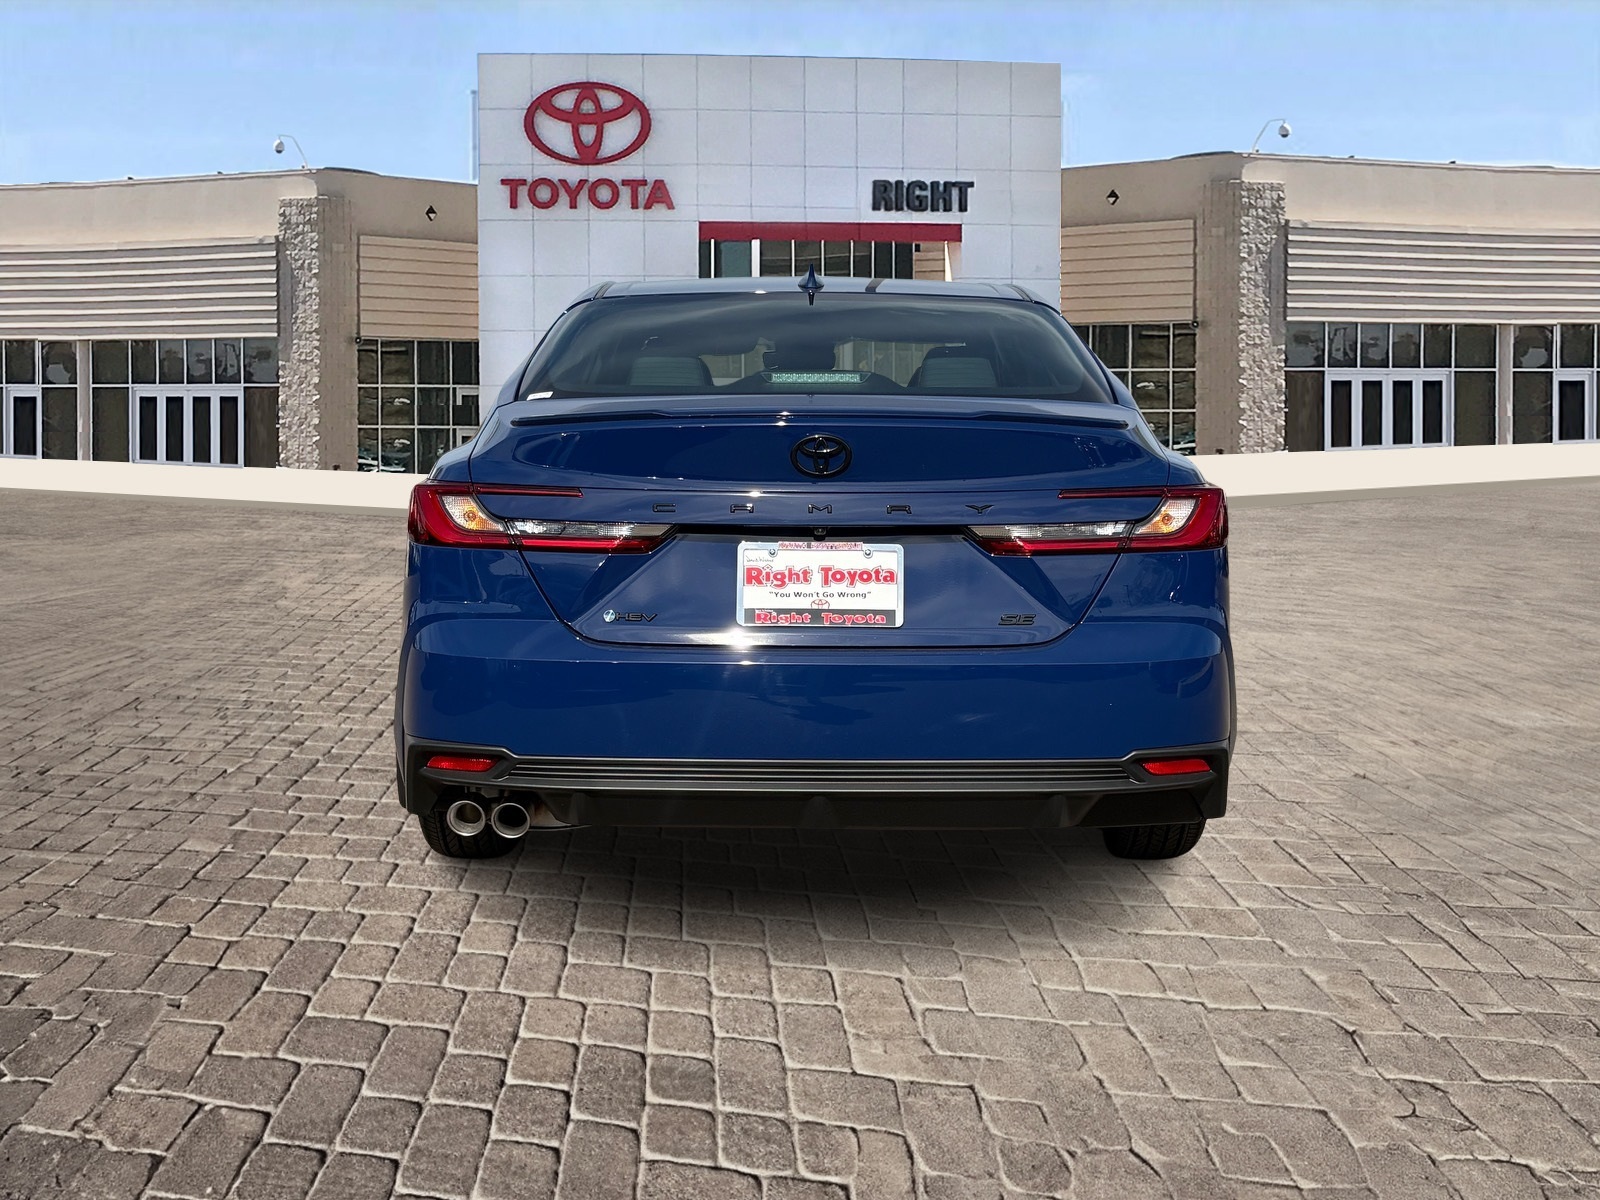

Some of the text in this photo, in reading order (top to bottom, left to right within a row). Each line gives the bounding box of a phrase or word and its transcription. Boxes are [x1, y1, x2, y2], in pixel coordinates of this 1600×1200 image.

[500, 178, 675, 210] TOYOTA
[872, 179, 975, 212] RIGHT
[652, 503, 994, 514] CAMRY
[745, 565, 896, 588] Right Toyota
[615, 611, 657, 623] HEV
[755, 612, 886, 625] Right Toyota
[998, 613, 1036, 625] SE
